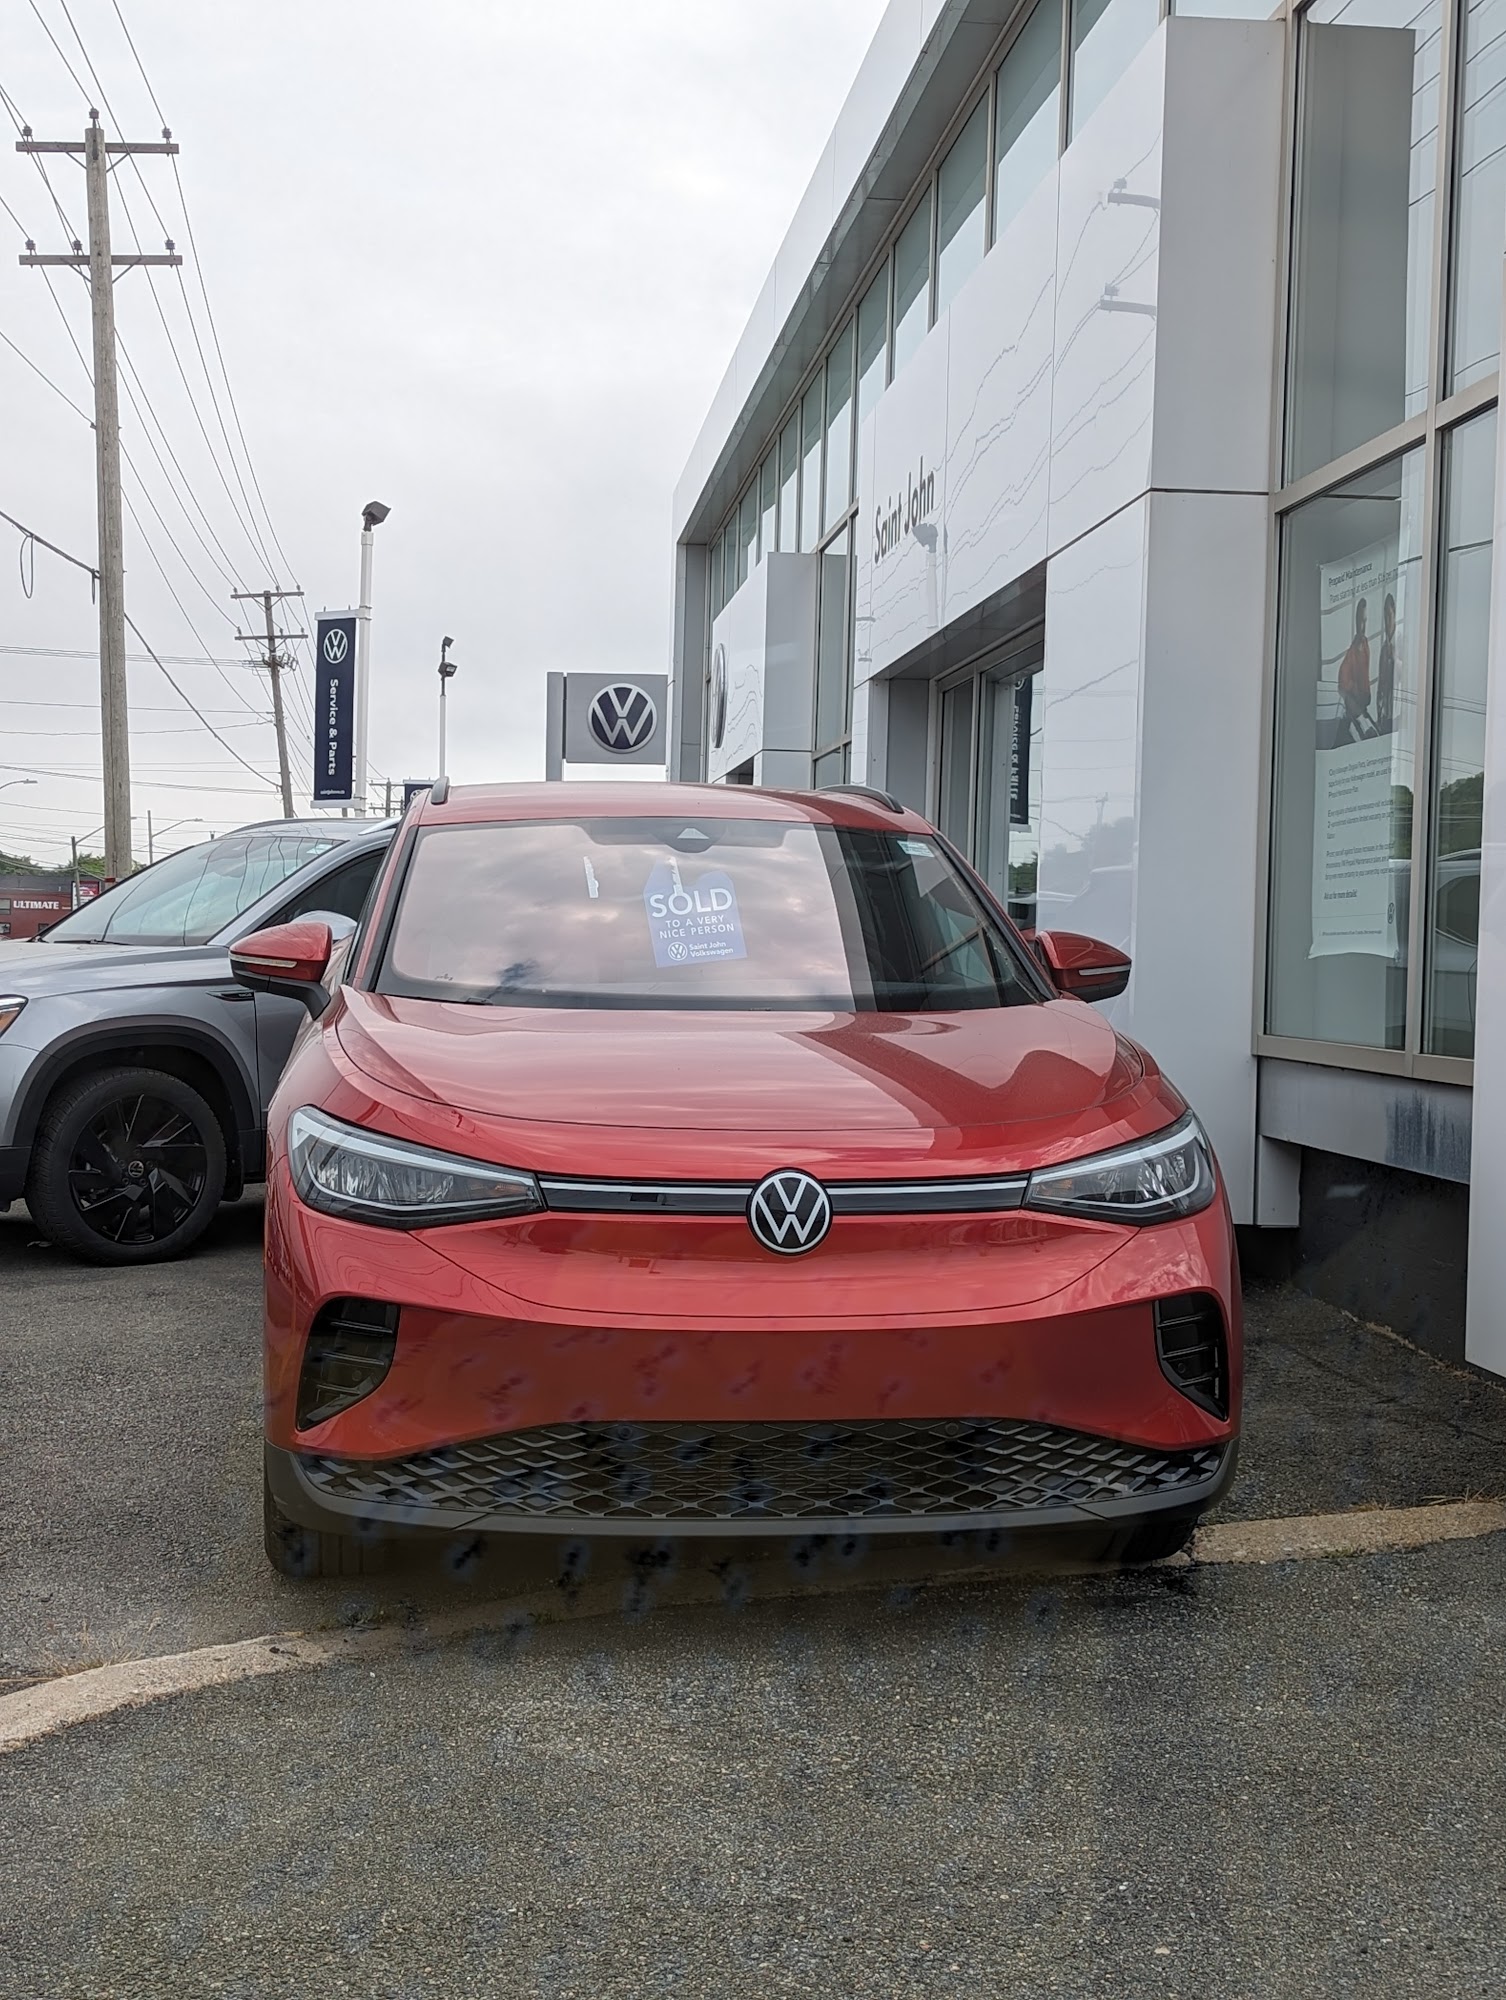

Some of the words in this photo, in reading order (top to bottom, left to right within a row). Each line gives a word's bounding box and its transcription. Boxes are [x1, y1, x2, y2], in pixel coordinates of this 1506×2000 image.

[874, 492, 902, 565] Saint
[904, 455, 935, 535] John
[329, 679, 339, 726] Service
[590, 685, 655, 750] VW
[328, 728, 338, 739] &
[328, 742, 337, 775] Parts
[13, 900, 60, 910] ULTIMATE
[650, 888, 732, 918] SOLD
[660, 929, 686, 939] NICE
[691, 924, 734, 935] PERSON
[665, 920, 680, 928] TO
[697, 915, 724, 925] VERY
[690, 948, 733, 957] Volkswagen
[752, 1174, 828, 1249] VW
